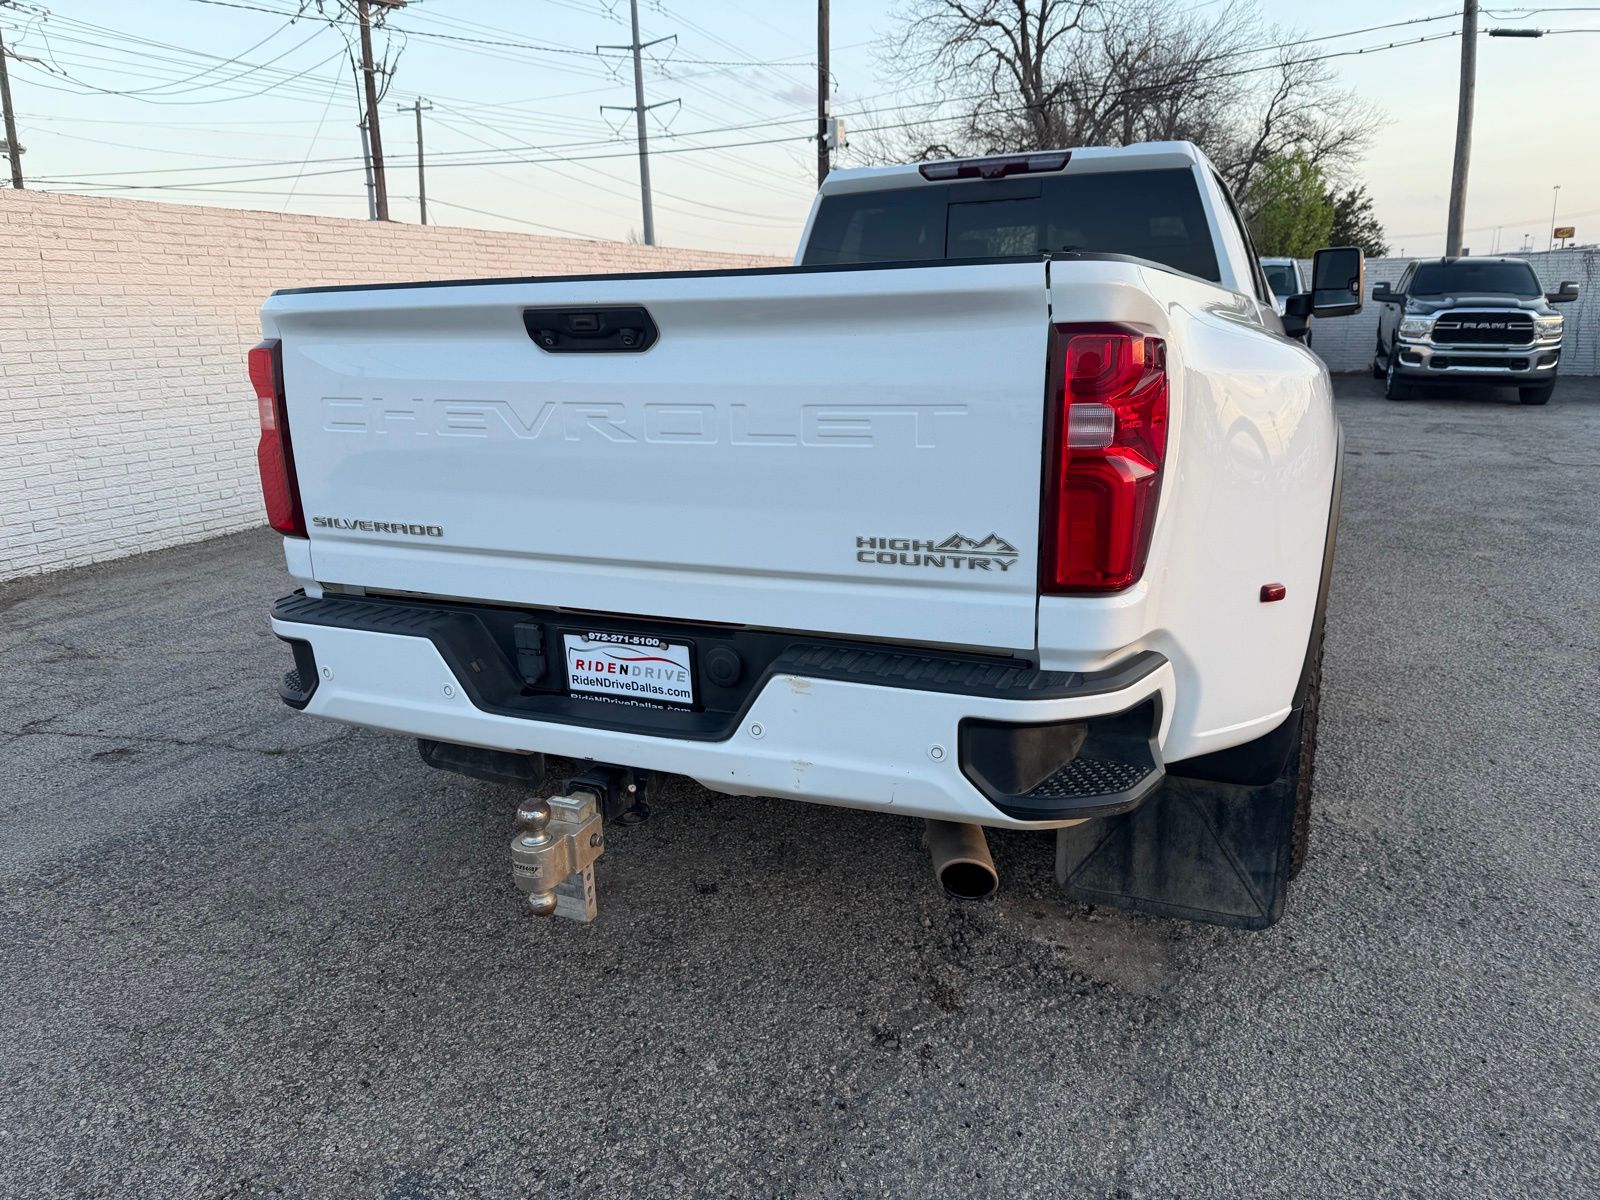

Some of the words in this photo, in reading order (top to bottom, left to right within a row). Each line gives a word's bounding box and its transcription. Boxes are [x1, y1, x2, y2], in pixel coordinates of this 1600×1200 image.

[321, 397, 968, 448] CHEVROLET
[312, 516, 444, 537] SILVERADO
[856, 536, 935, 552] HIGH
[856, 550, 1018, 571] COUNTRY
[588, 632, 660, 646] 972-271-5100
[571, 675, 691, 699] RideNDriveDallas.com
